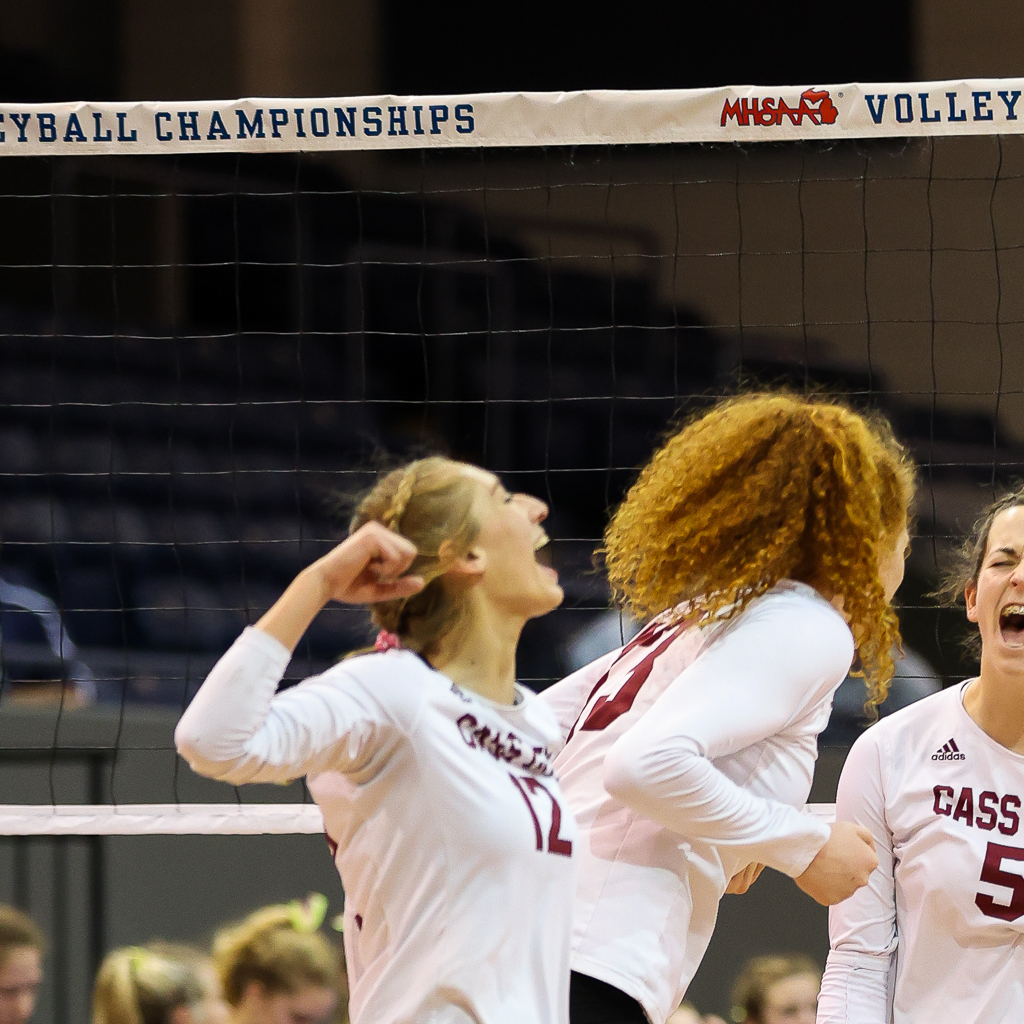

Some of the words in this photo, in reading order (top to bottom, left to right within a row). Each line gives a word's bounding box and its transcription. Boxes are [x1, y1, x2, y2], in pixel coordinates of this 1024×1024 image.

[154, 103, 475, 142] CHAMPIONSHIPS
[931, 751, 966, 761] adidas
[508, 772, 573, 858] 12
[932, 785, 1022, 836] CASS
